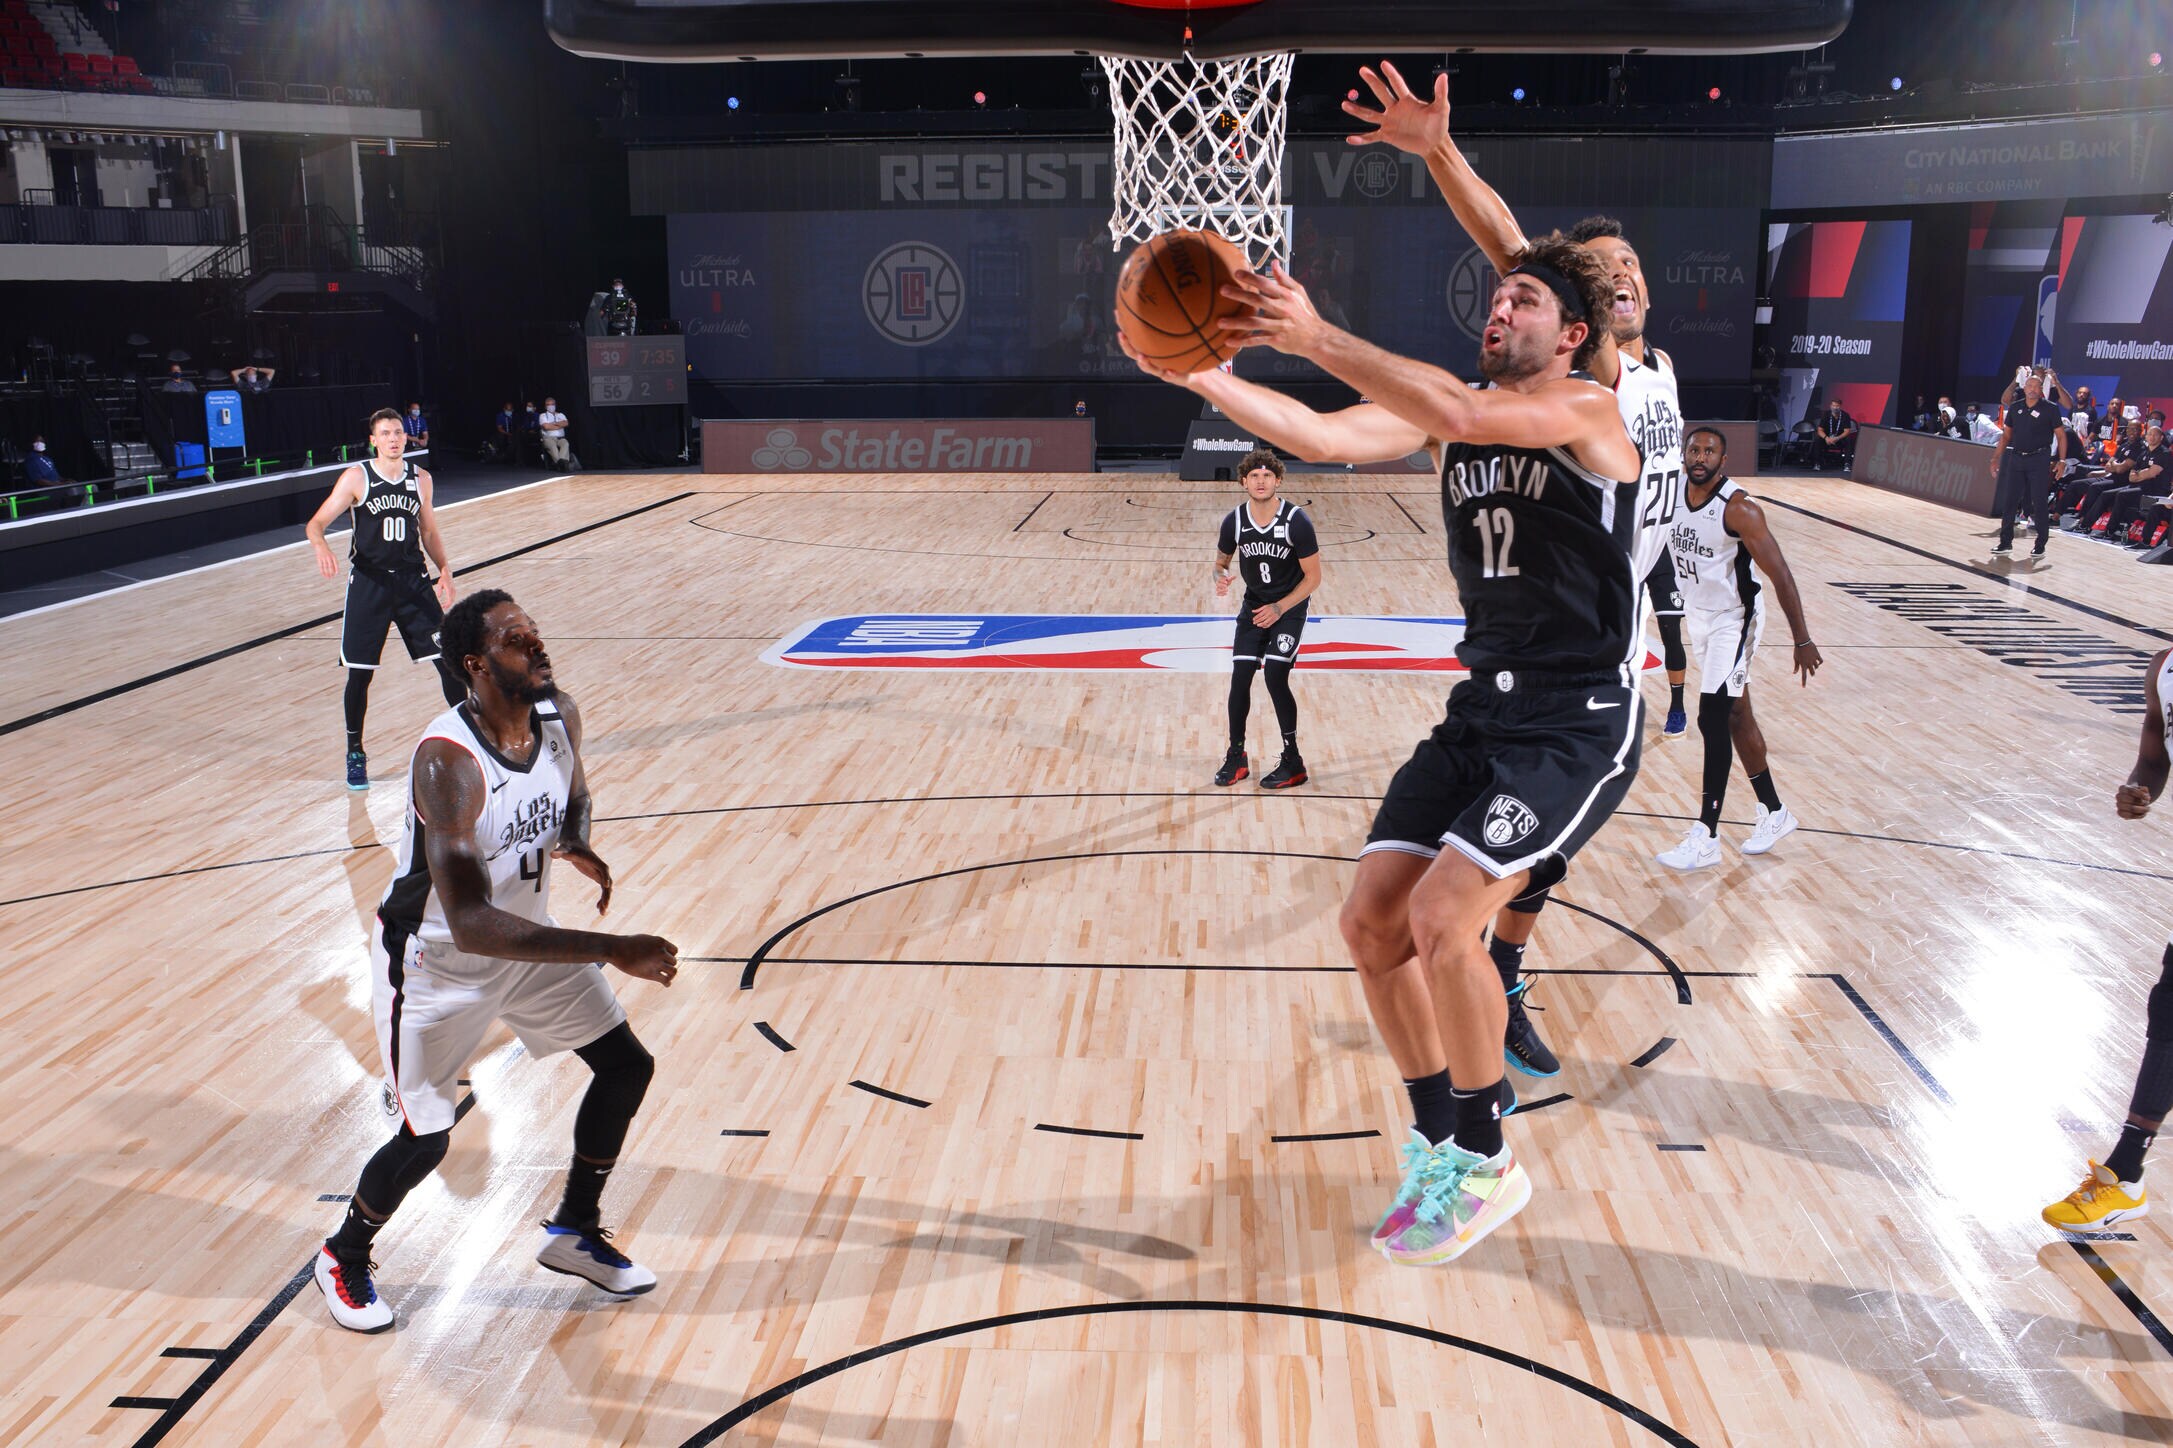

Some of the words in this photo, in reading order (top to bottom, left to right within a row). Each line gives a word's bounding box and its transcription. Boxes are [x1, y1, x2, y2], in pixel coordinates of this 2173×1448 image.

[879, 153, 1150, 201] REGIST
[680, 269, 756, 287] ULTRA
[1665, 266, 1745, 284] ULTRA
[1790, 335, 1832, 354] 2019-20
[1832, 335, 1872, 354] Season
[2086, 340, 2173, 360] #WholeNewGam
[600, 350, 620, 366] 39
[640, 349, 675, 365] 7:35
[603, 384, 622, 399] 56
[640, 382, 651, 396] 2
[1192, 438, 1255, 452] #WholeNewGame
[365, 494, 421, 517] BROOKLYN
[1643, 470, 1680, 529] 20
[383, 516, 406, 542] 00
[1239, 541, 1292, 560] BROOKLYN
[1472, 507, 1520, 578] 12
[1259, 562, 1272, 584] 8
[1676, 556, 1700, 584] 54
[837, 620, 985, 646] NBA
[1490, 797, 1534, 835] NETS
[486, 798, 565, 861] Angele
[519, 847, 545, 893] 4
